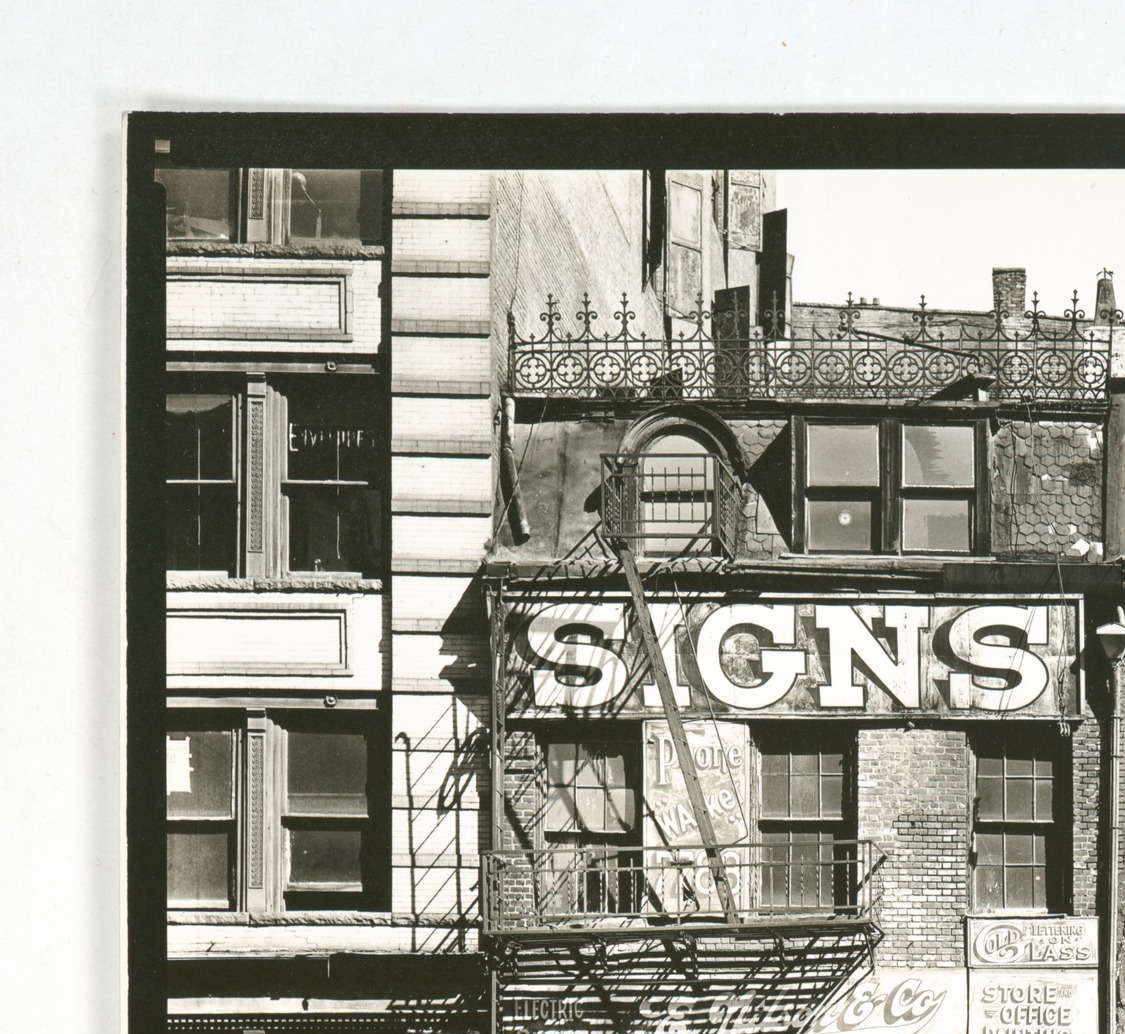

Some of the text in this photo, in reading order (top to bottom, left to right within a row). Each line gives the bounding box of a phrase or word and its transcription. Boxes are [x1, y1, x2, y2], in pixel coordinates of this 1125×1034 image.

[521, 602, 1049, 711] SIGNS
[655, 736, 743, 787] Pone
[1032, 924, 1084, 936] LETTERING
[981, 984, 1058, 1004] STORE
[515, 999, 584, 1020] ELECTRIC
[1000, 1005, 1073, 1026] OFFICE
